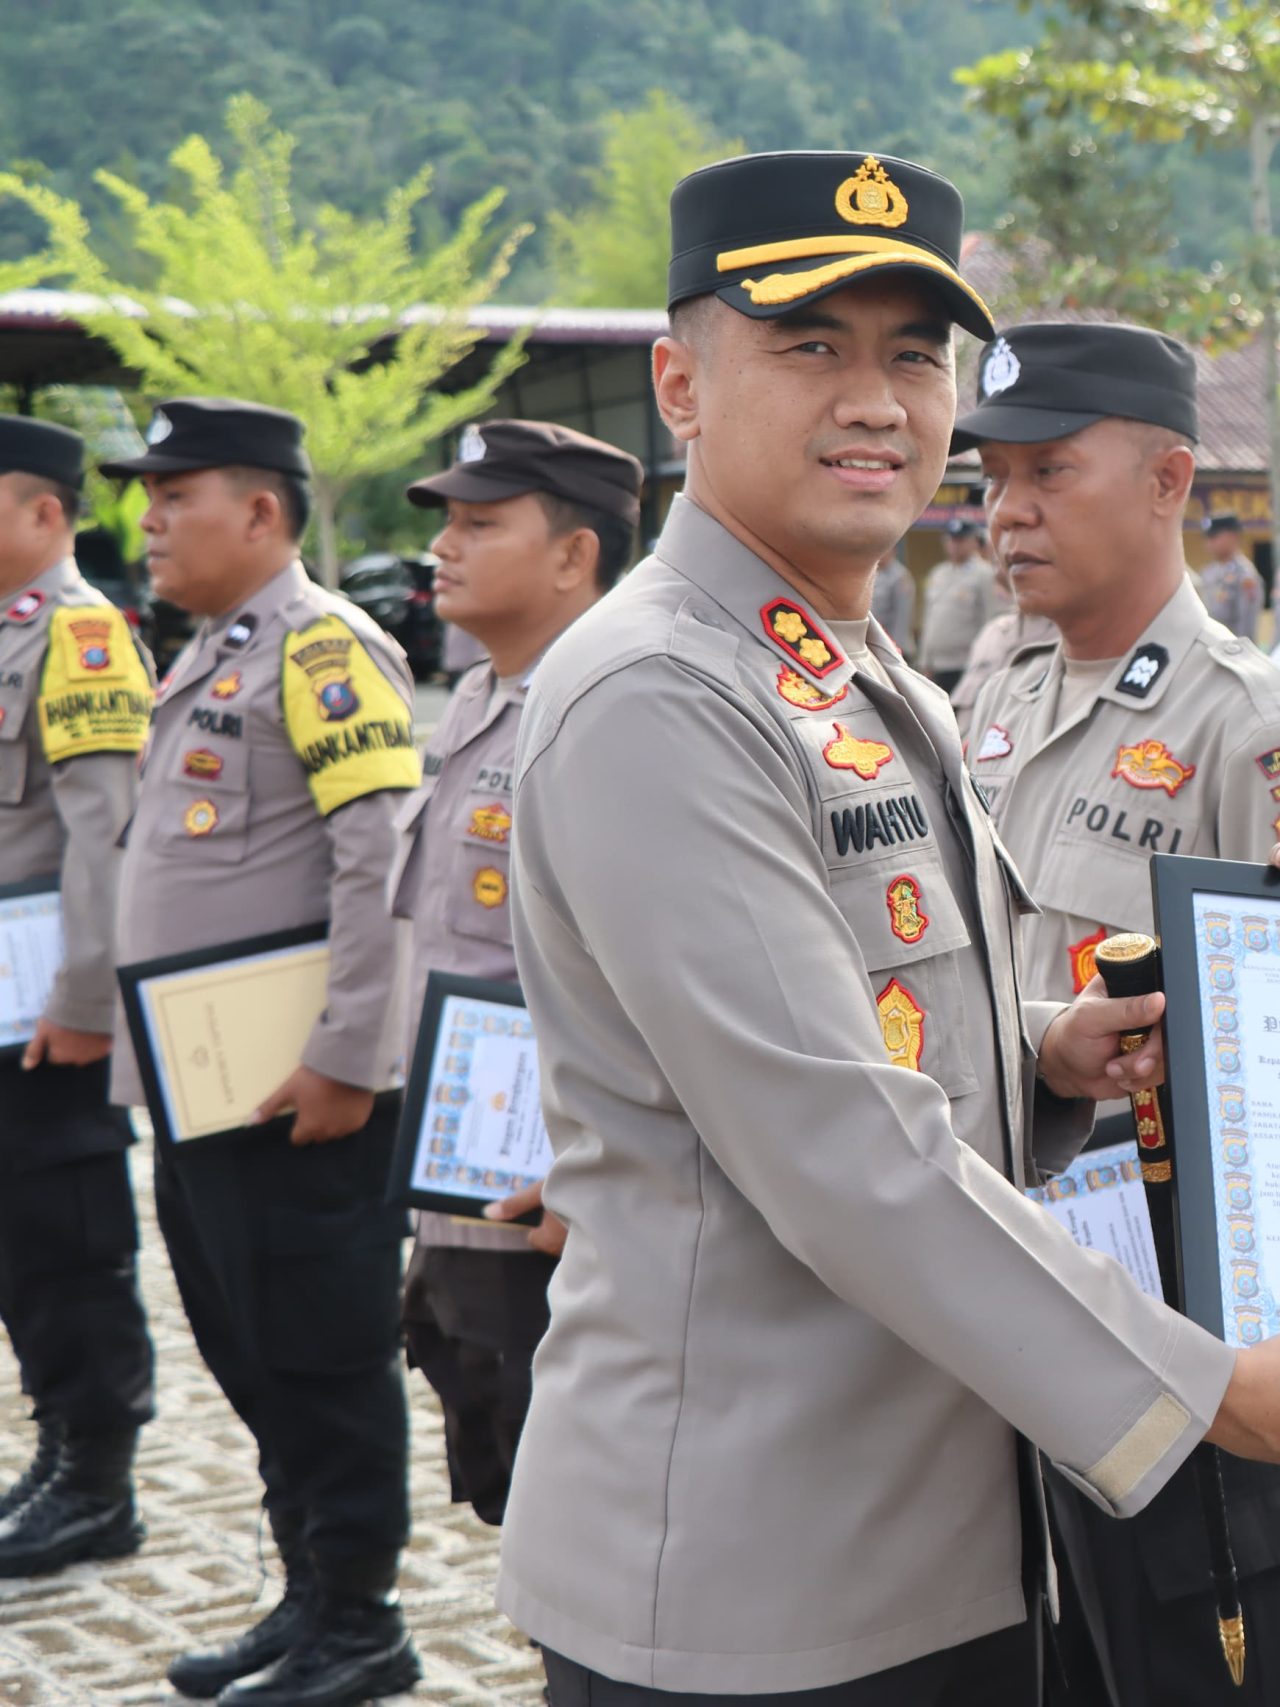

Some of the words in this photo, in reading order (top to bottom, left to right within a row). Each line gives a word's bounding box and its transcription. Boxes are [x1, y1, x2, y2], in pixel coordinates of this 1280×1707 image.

[187, 708, 243, 738] POLRI
[478, 768, 513, 791] POL
[831, 795, 928, 856] WAHYU
[1067, 798, 1183, 854] POLRI
